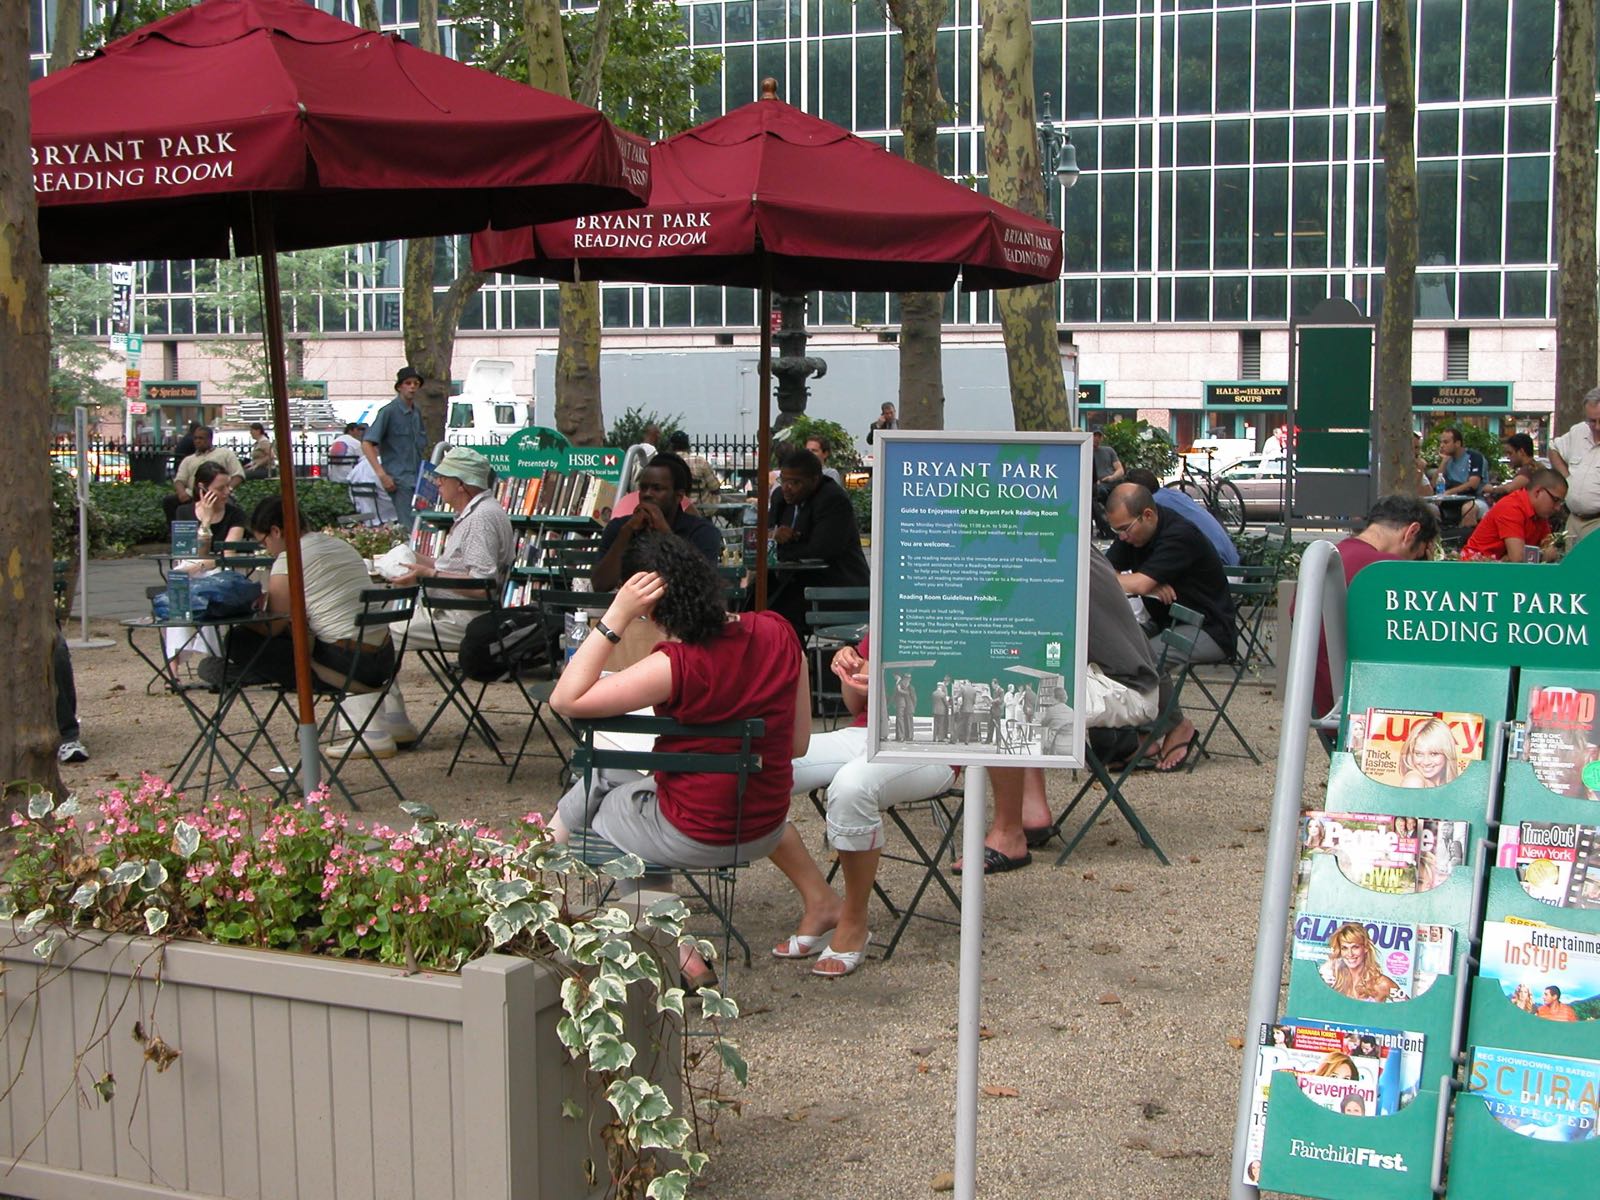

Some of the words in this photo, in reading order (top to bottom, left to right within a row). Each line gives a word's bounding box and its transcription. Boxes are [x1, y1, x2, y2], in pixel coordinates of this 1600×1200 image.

[30, 140, 144, 165] BRYANT
[159, 132, 237, 158] PARK
[33, 168, 144, 193] READING
[155, 160, 234, 186] ROOM
[575, 214, 653, 230] BRYANT
[663, 212, 711, 228] PARK
[574, 234, 652, 248] READING
[658, 231, 707, 247] ROOM
[1004, 228, 1034, 247] BRYANT
[1035, 235, 1053, 251] PARK
[159, 387, 180, 398] Sprint
[181, 388, 197, 397] Store
[1234, 395, 1262, 403] SOUPS
[1439, 388, 1476, 396] BELLEZA
[1463, 397, 1483, 405] SHOP
[490, 454, 510, 463] PARK
[517, 459, 548, 468] Presented
[549, 460, 558, 469] by
[569, 454, 600, 467] HSBC
[903, 461, 991, 478] BRYANT
[1002, 463, 1059, 479] PARK
[902, 482, 990, 498] READING
[998, 483, 1058, 499] ROOM
[1015, 509, 1040, 517] Reading
[899, 593, 922, 601] Reading
[1385, 589, 1499, 613] BRYANT
[1512, 592, 1589, 615] PARK
[1386, 619, 1498, 643] READING
[1507, 622, 1589, 646] ROOM
[1532, 690, 1596, 723] WWD
[1371, 717, 1484, 754] Luy.
[1365, 758, 1397, 769] lashes:
[1366, 749, 1391, 760] Thick
[1522, 822, 1550, 846] Time
[1550, 825, 1574, 847] Out
[1521, 846, 1547, 858] New
[1547, 848, 1571, 860] York
[1295, 916, 1413, 951] GLAOUR
[1505, 940, 1568, 973] InStyle
[1496, 1055, 1553, 1072] SHOWDOWN:
[1299, 1077, 1375, 1102] Prevention
[1470, 1060, 1600, 1111] SCUBA
[1520, 1090, 1590, 1115] DIVING
[1484, 1099, 1590, 1129] NEXPECTED
